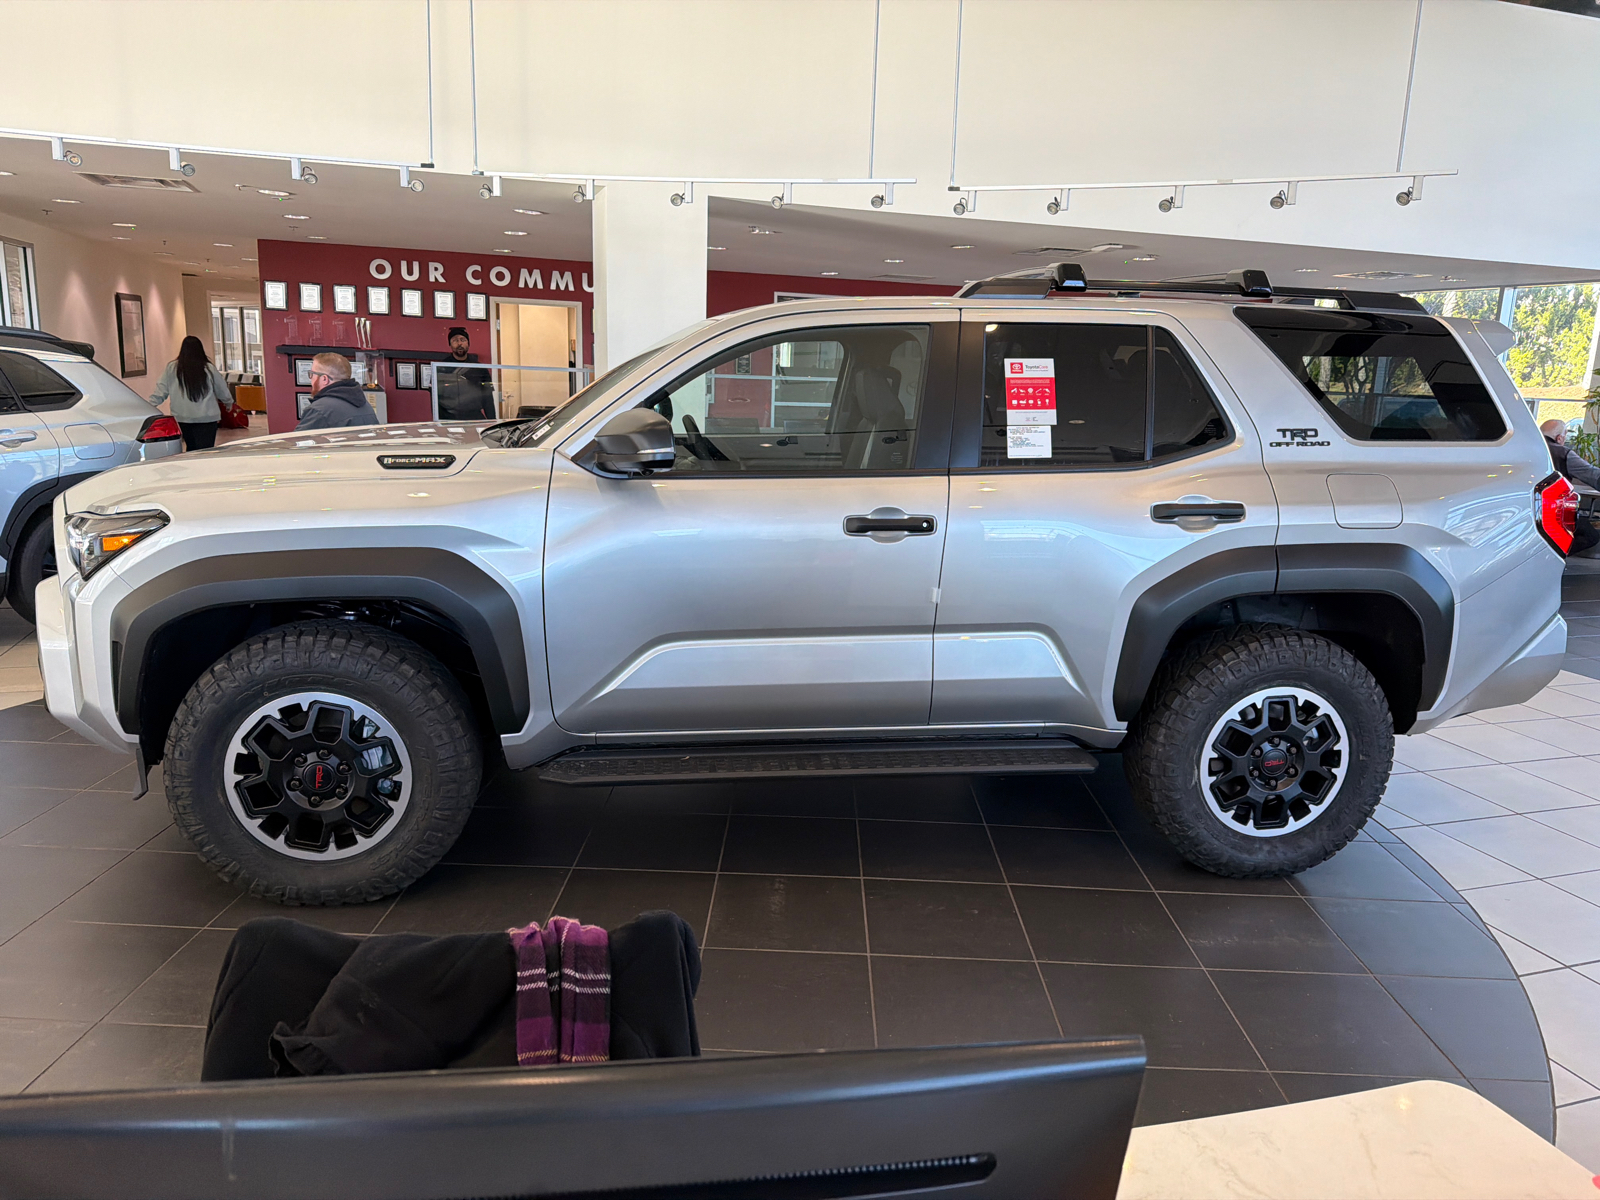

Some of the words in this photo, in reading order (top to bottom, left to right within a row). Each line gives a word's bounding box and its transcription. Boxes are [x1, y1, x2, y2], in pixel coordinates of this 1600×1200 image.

[369, 258, 446, 283] OUR
[465, 264, 594, 293] COMMU
[1276, 428, 1319, 441] TRD
[315, 765, 324, 789] TRD
